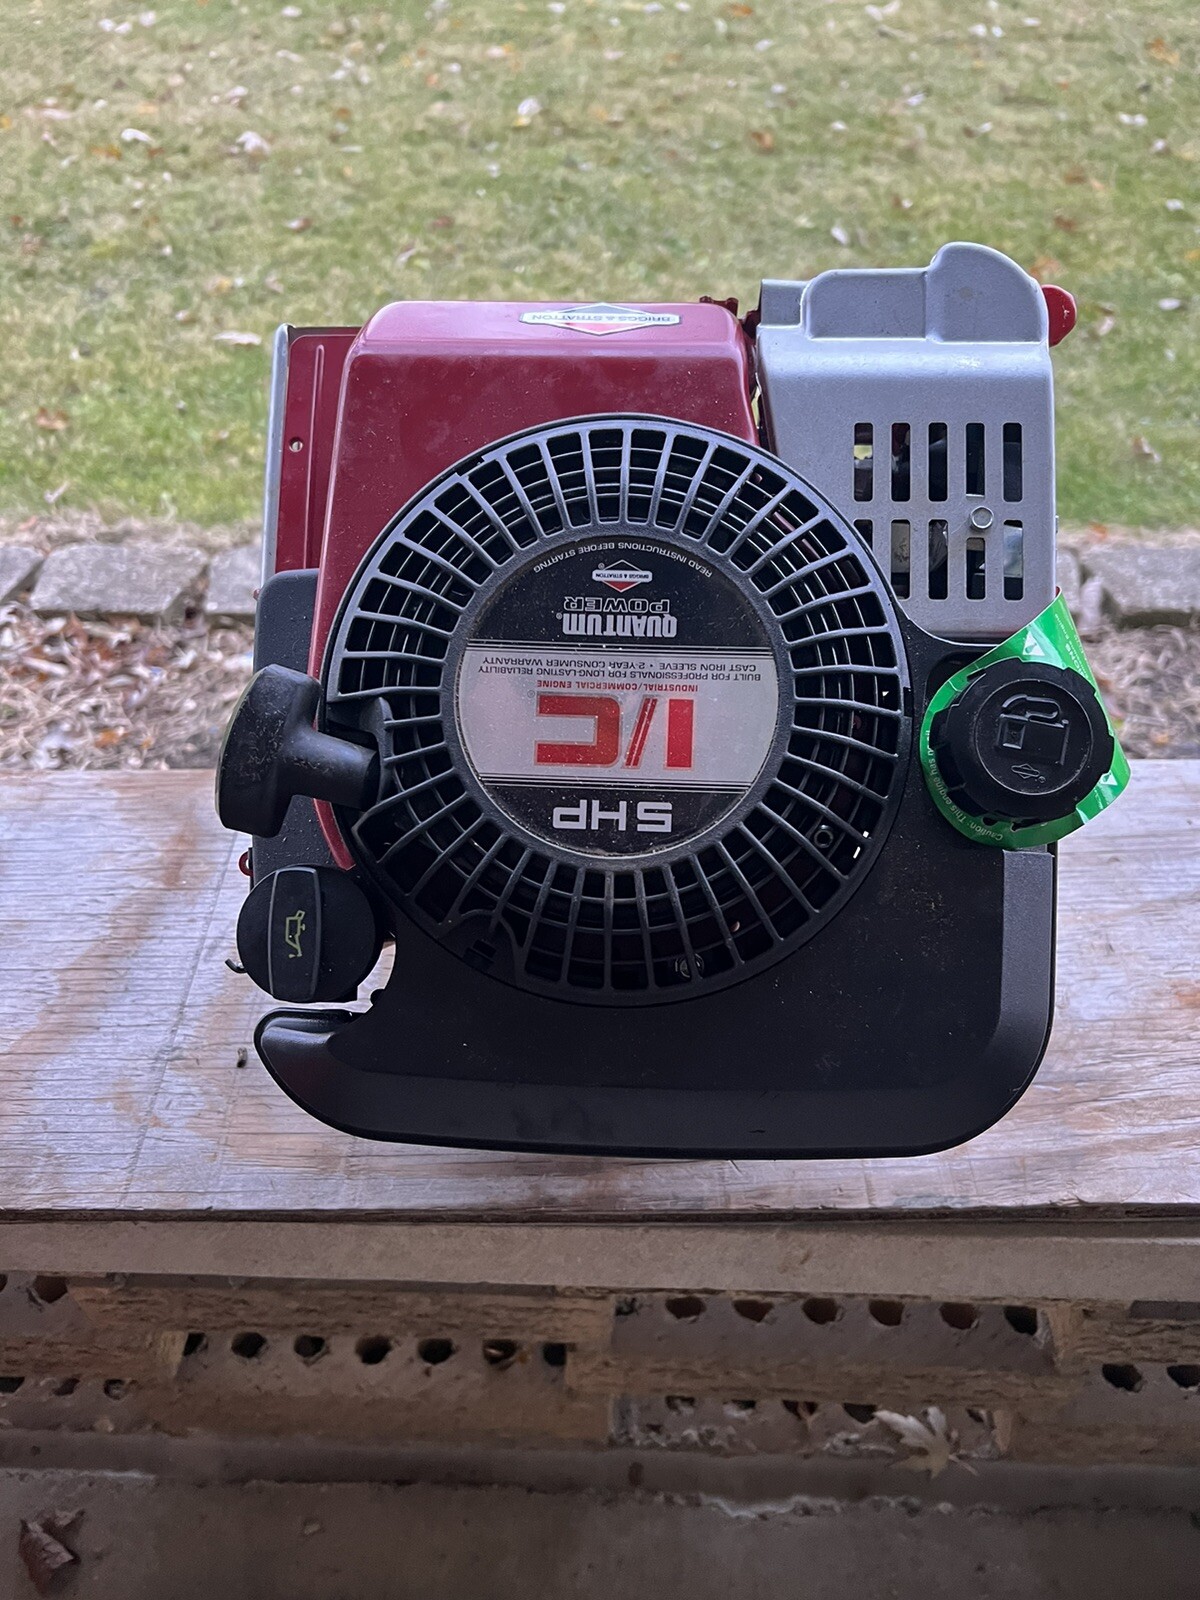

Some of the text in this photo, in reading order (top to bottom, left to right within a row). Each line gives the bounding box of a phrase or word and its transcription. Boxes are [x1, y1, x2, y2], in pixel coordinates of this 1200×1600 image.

[578, 542, 615, 555] BEFORE
[618, 542, 687, 563] INSTRUCTIONS
[688, 558, 712, 578] READ
[563, 596, 670, 614] POWER
[562, 612, 678, 638] QUANTUM
[478, 665, 761, 681] BUILT FOR PROFESSIONALS FOR LONG-LASTING RELIABILITY
[482, 657, 757, 672] CAST IRON SLEEVE 2-YEAR CONSUMER WARRANTY
[537, 679, 698, 692] INDUSTRIAL/COMMERCIAL ENGINE
[534, 691, 694, 770] I/C
[928, 758, 938, 776] has
[934, 777, 953, 805] engine
[552, 799, 673, 833] 5 HP
[950, 804, 967, 824] This
